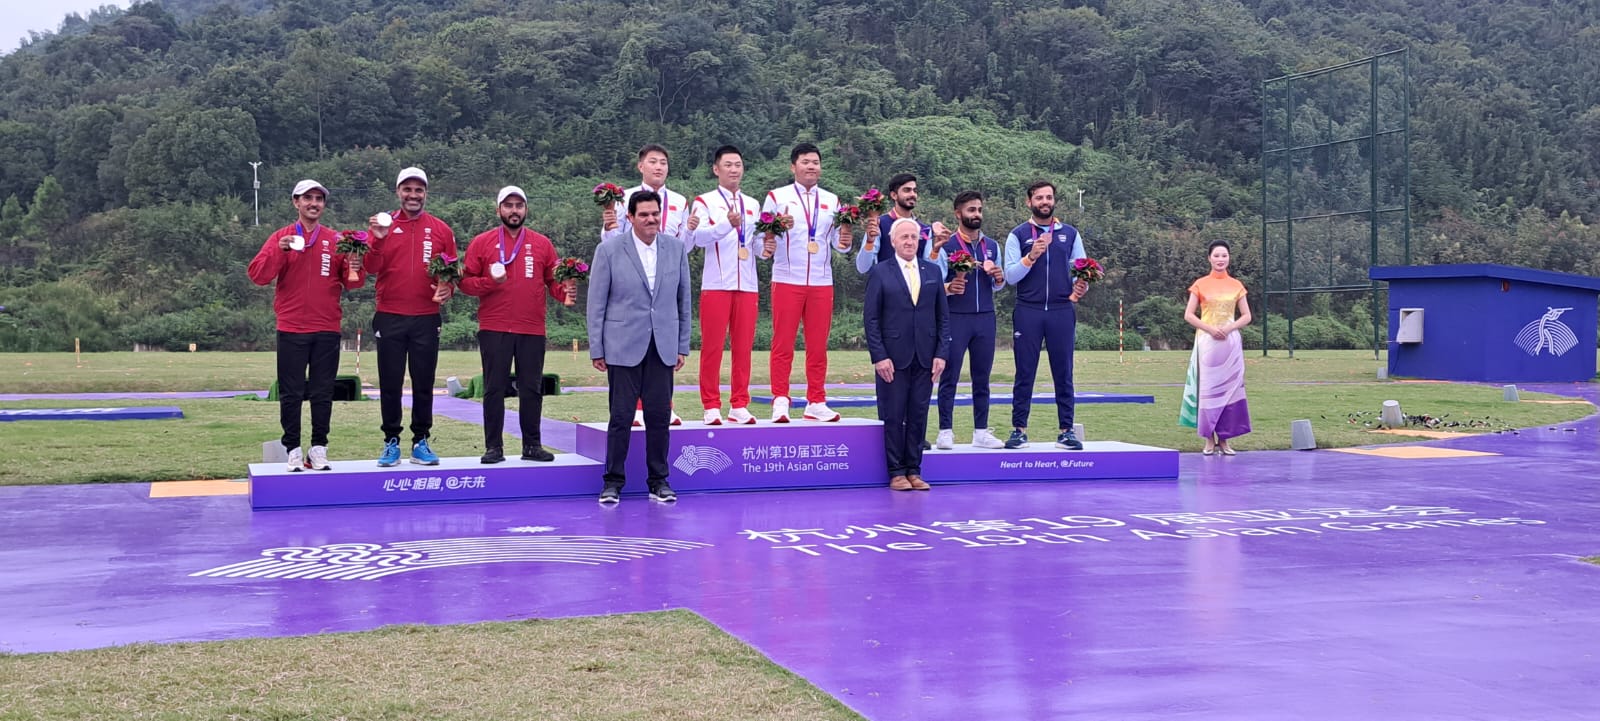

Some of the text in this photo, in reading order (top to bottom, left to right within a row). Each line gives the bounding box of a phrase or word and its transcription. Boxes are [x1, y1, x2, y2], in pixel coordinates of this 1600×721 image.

[321, 253, 331, 276] QATAR
[525, 256, 533, 278] QATAR
[742, 443, 849, 460] 杭州第19届亚运会
[742, 461, 849, 473] The 19th Asian Games
[1000, 461, 1022, 469] Heart
[1034, 460, 1059, 469] Heart,
[1061, 460, 1095, 468] @Future
[736, 504, 1476, 544] 杭州第19届亚运会
[771, 516, 1547, 557] The 19th Asian Games
